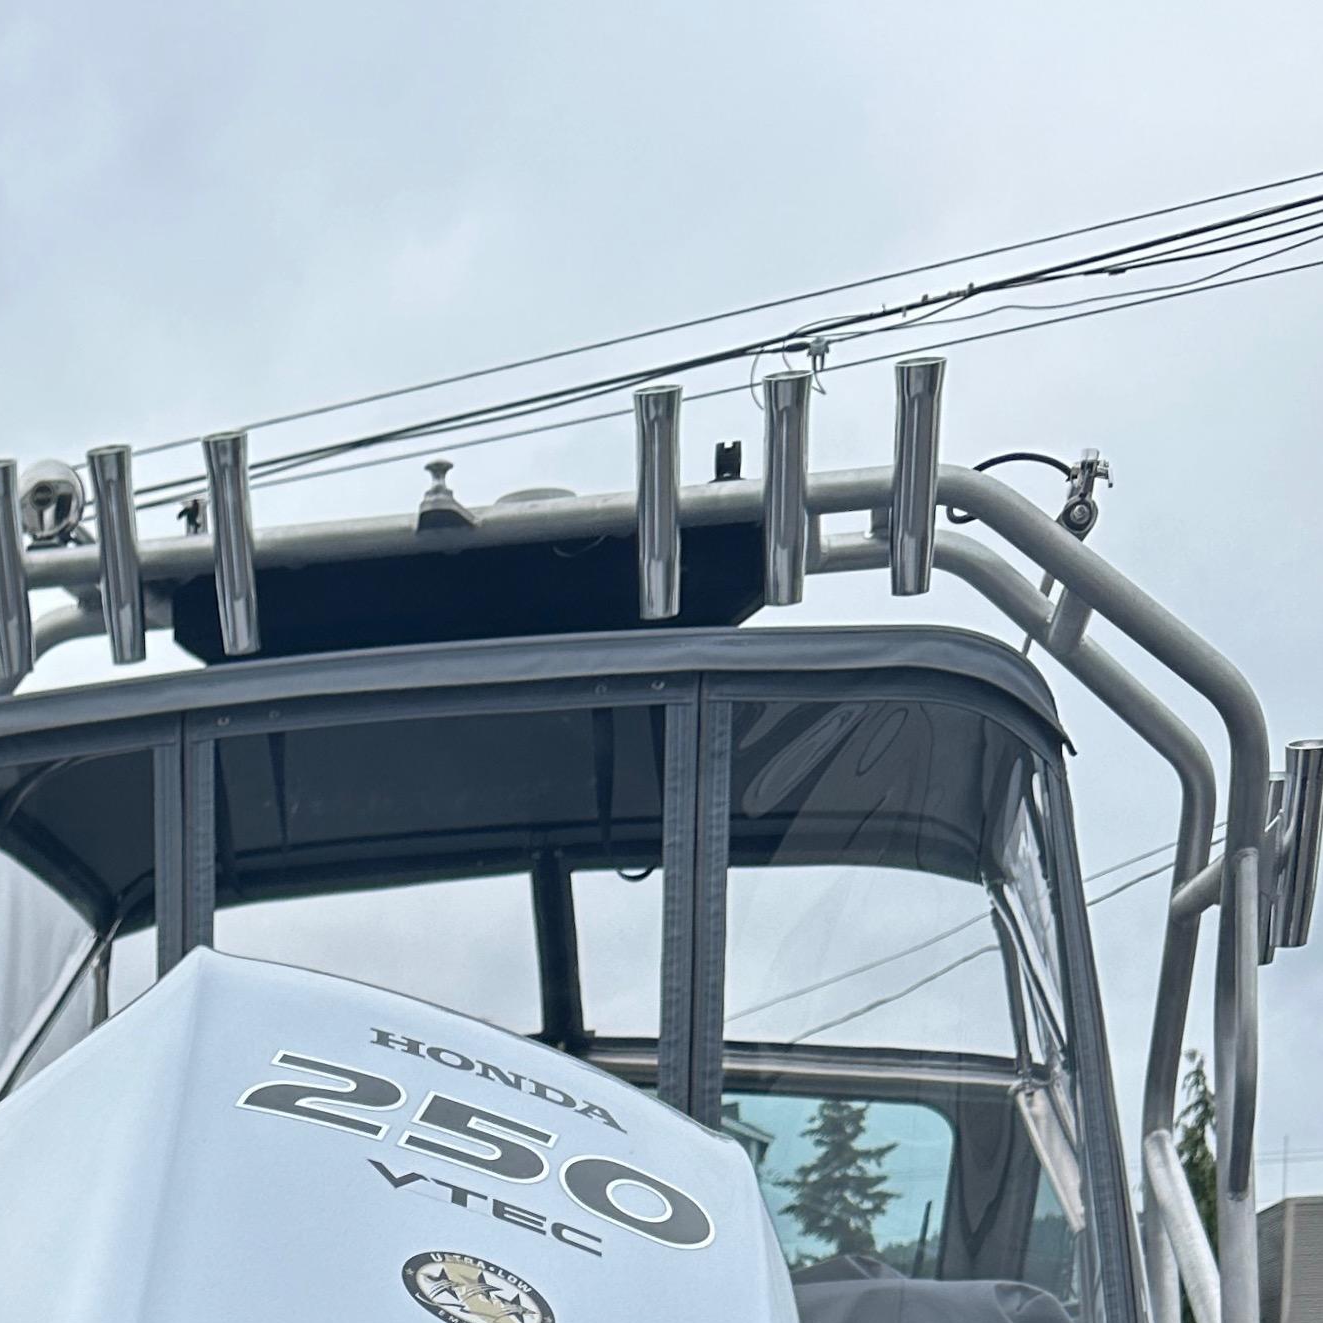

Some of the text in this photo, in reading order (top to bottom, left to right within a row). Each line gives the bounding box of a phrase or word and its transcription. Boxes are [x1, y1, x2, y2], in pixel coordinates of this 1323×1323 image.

[370, 1027, 628, 1134] HONDA
[234, 1049, 716, 1251] 250
[367, 1158, 603, 1258] VTEC
